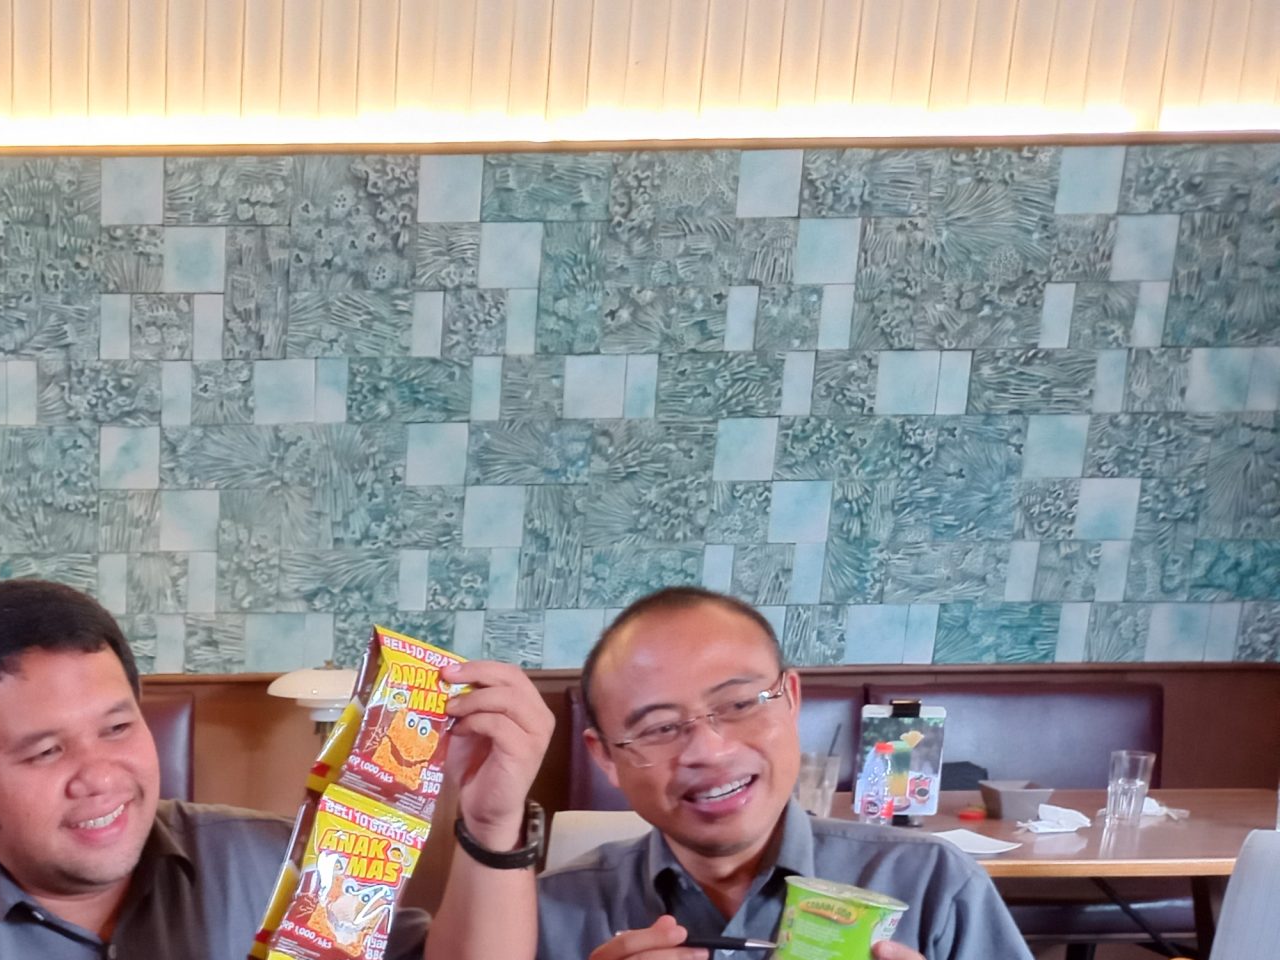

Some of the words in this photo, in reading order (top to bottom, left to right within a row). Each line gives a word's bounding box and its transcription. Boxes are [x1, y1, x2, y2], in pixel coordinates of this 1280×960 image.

[390, 663, 440, 692] ANAK
[408, 689, 447, 715] MAS
[420, 767, 444, 783] Ayam
[422, 782, 441, 795] BBQ
[321, 830, 388, 860] ANAK
[370, 818, 415, 845] GRATIS
[347, 855, 400, 883] MAS
